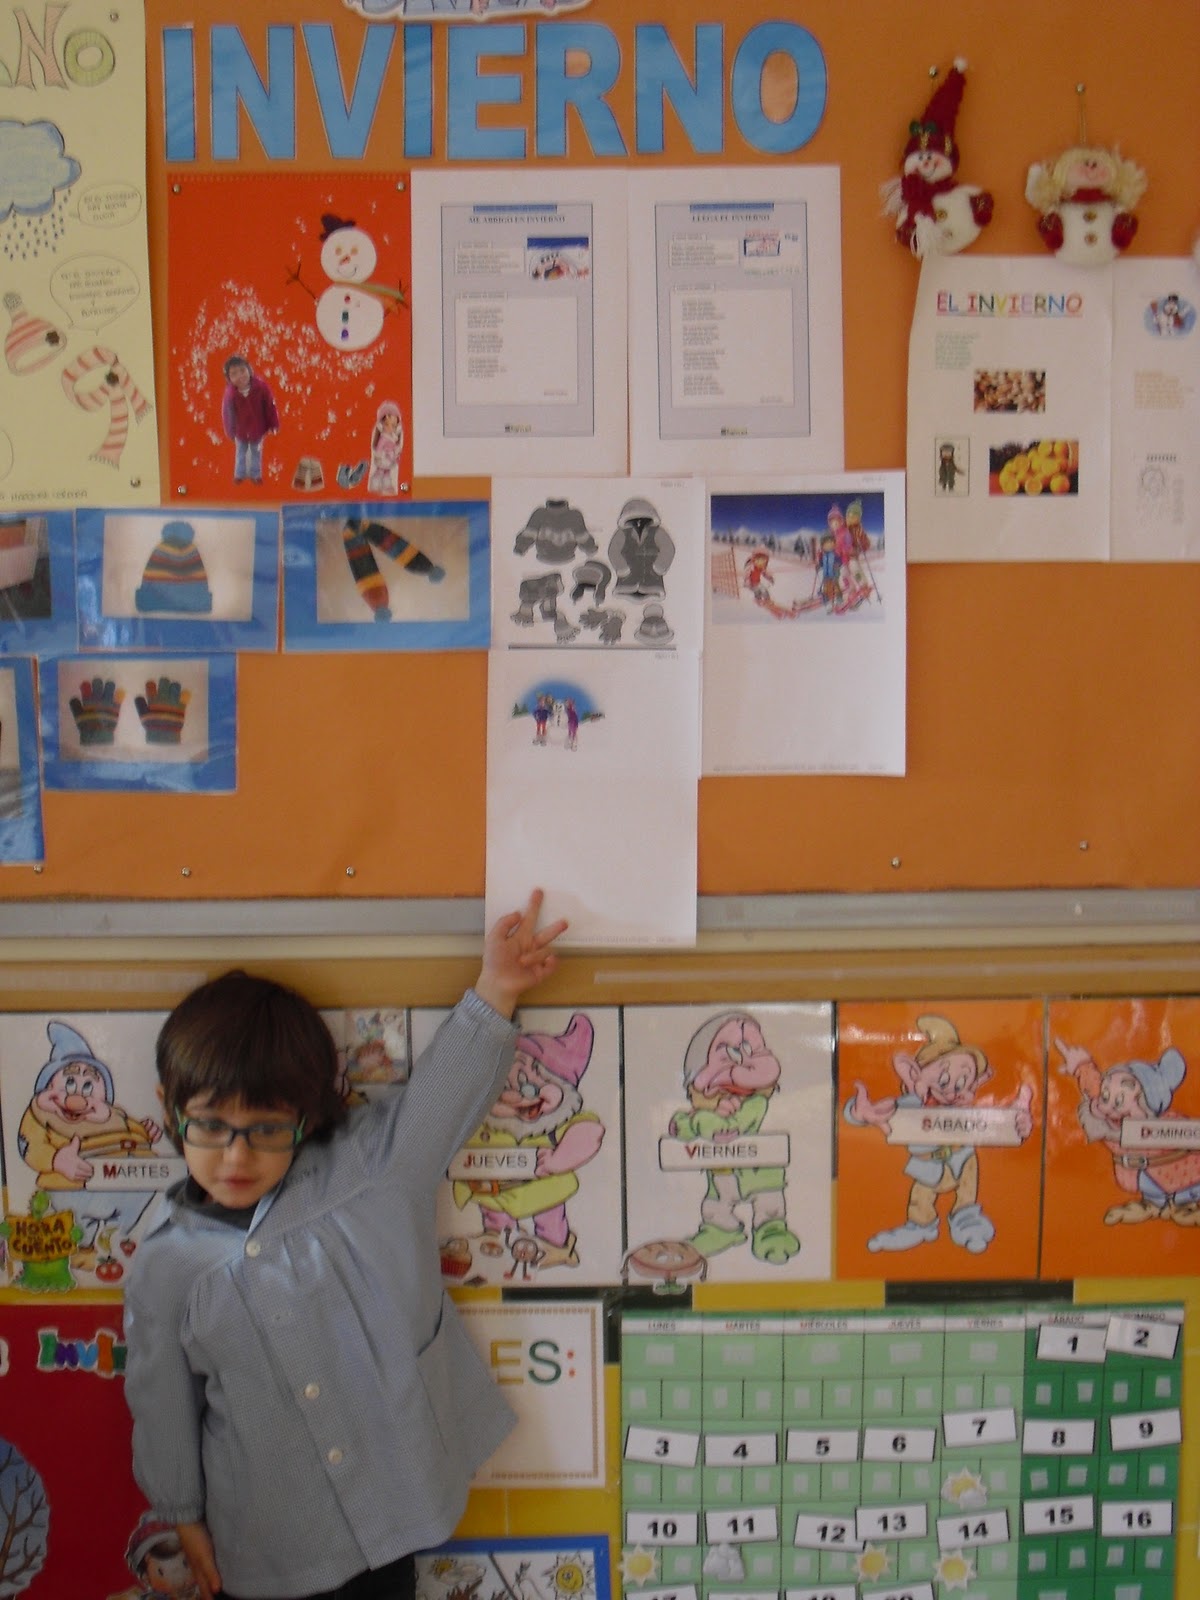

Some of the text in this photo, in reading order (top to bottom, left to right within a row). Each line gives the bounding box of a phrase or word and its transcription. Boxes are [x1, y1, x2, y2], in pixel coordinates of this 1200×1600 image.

[0, 2, 116, 90] NO
[162, 20, 828, 162] INVIERNO
[936, 290, 1083, 314] EL INVIERNO
[463, 1154, 528, 1169] JUEVES
[685, 1144, 758, 1159] VIERNES
[103, 1163, 169, 1179] MARTES
[15, 1218, 65, 1237] HORA
[725, 1320, 760, 1331] MARTES
[887, 1319, 921, 1329] JUEVES
[967, 1318, 1004, 1329] VIERNES
[1067, 1333, 1079, 1354] 1
[1133, 1327, 1150, 1348] 2
[972, 1418, 987, 1437] 7
[1139, 1419, 1154, 1439] 9
[654, 1437, 670, 1457] 3
[815, 1436, 830, 1456] 5
[892, 1433, 907, 1453] 6
[1051, 1428, 1066, 1448] 8
[732, 1440, 749, 1459] 4
[877, 1512, 907, 1533] 13
[1045, 1505, 1074, 1525] 15
[1123, 1510, 1152, 1529] 16
[648, 1520, 677, 1538] 10
[727, 1516, 756, 1536] 11
[816, 1523, 847, 1543] 12
[958, 1520, 989, 1541] 14
